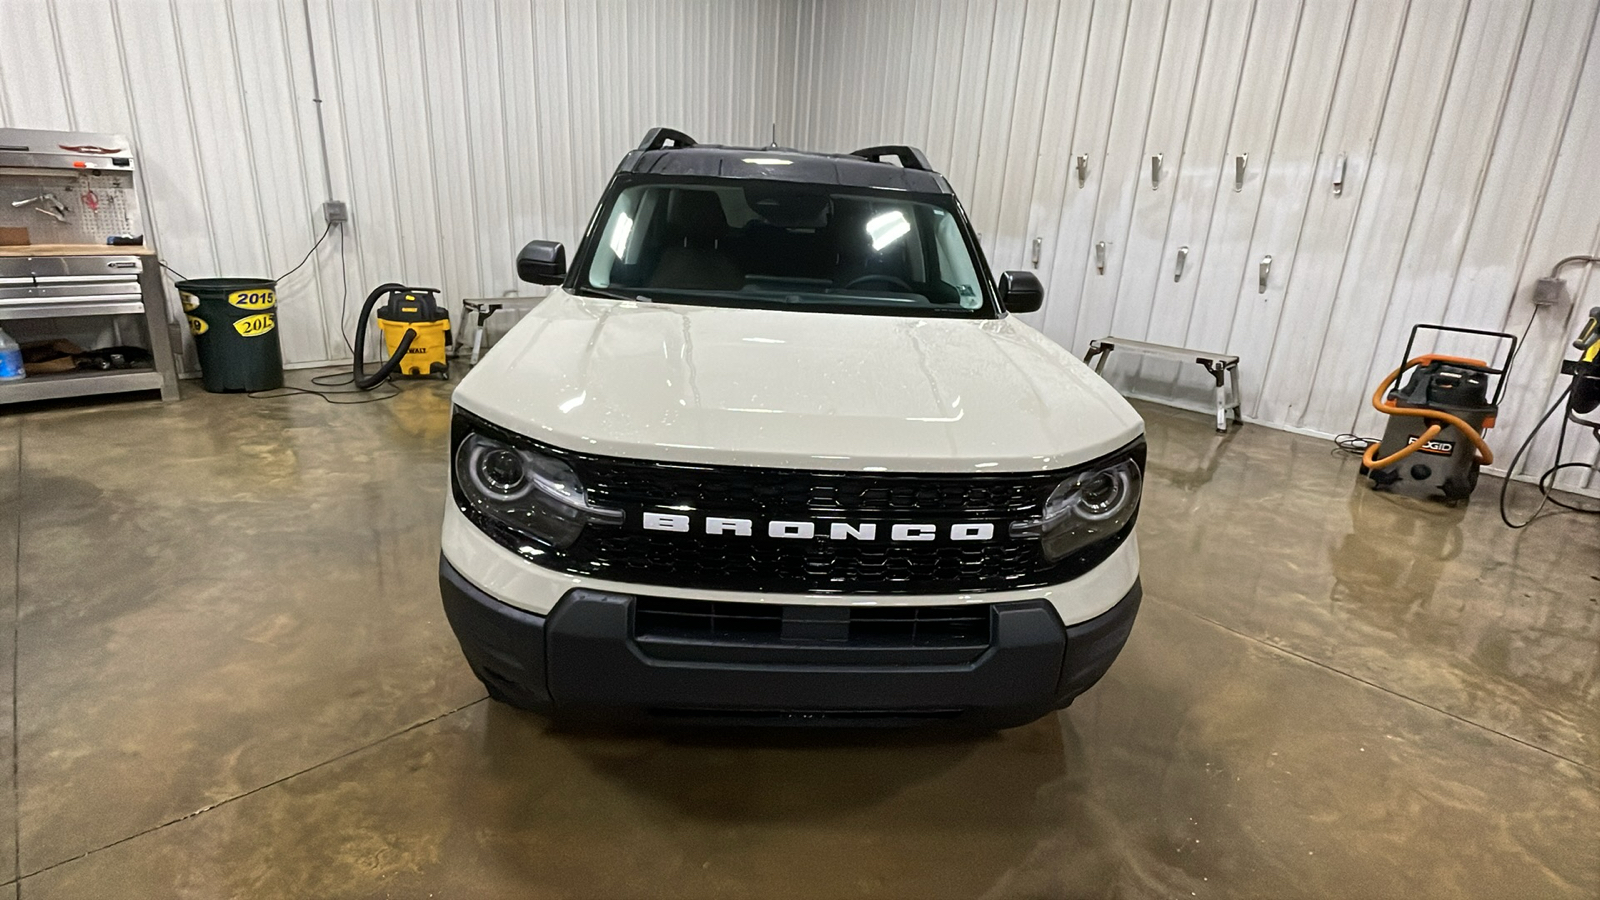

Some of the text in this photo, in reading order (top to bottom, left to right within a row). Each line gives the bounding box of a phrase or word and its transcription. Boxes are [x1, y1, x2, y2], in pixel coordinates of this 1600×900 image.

[236, 292, 273, 305] 2015
[1408, 437, 1452, 451] RDGID
[643, 512, 994, 540] BRONCO
